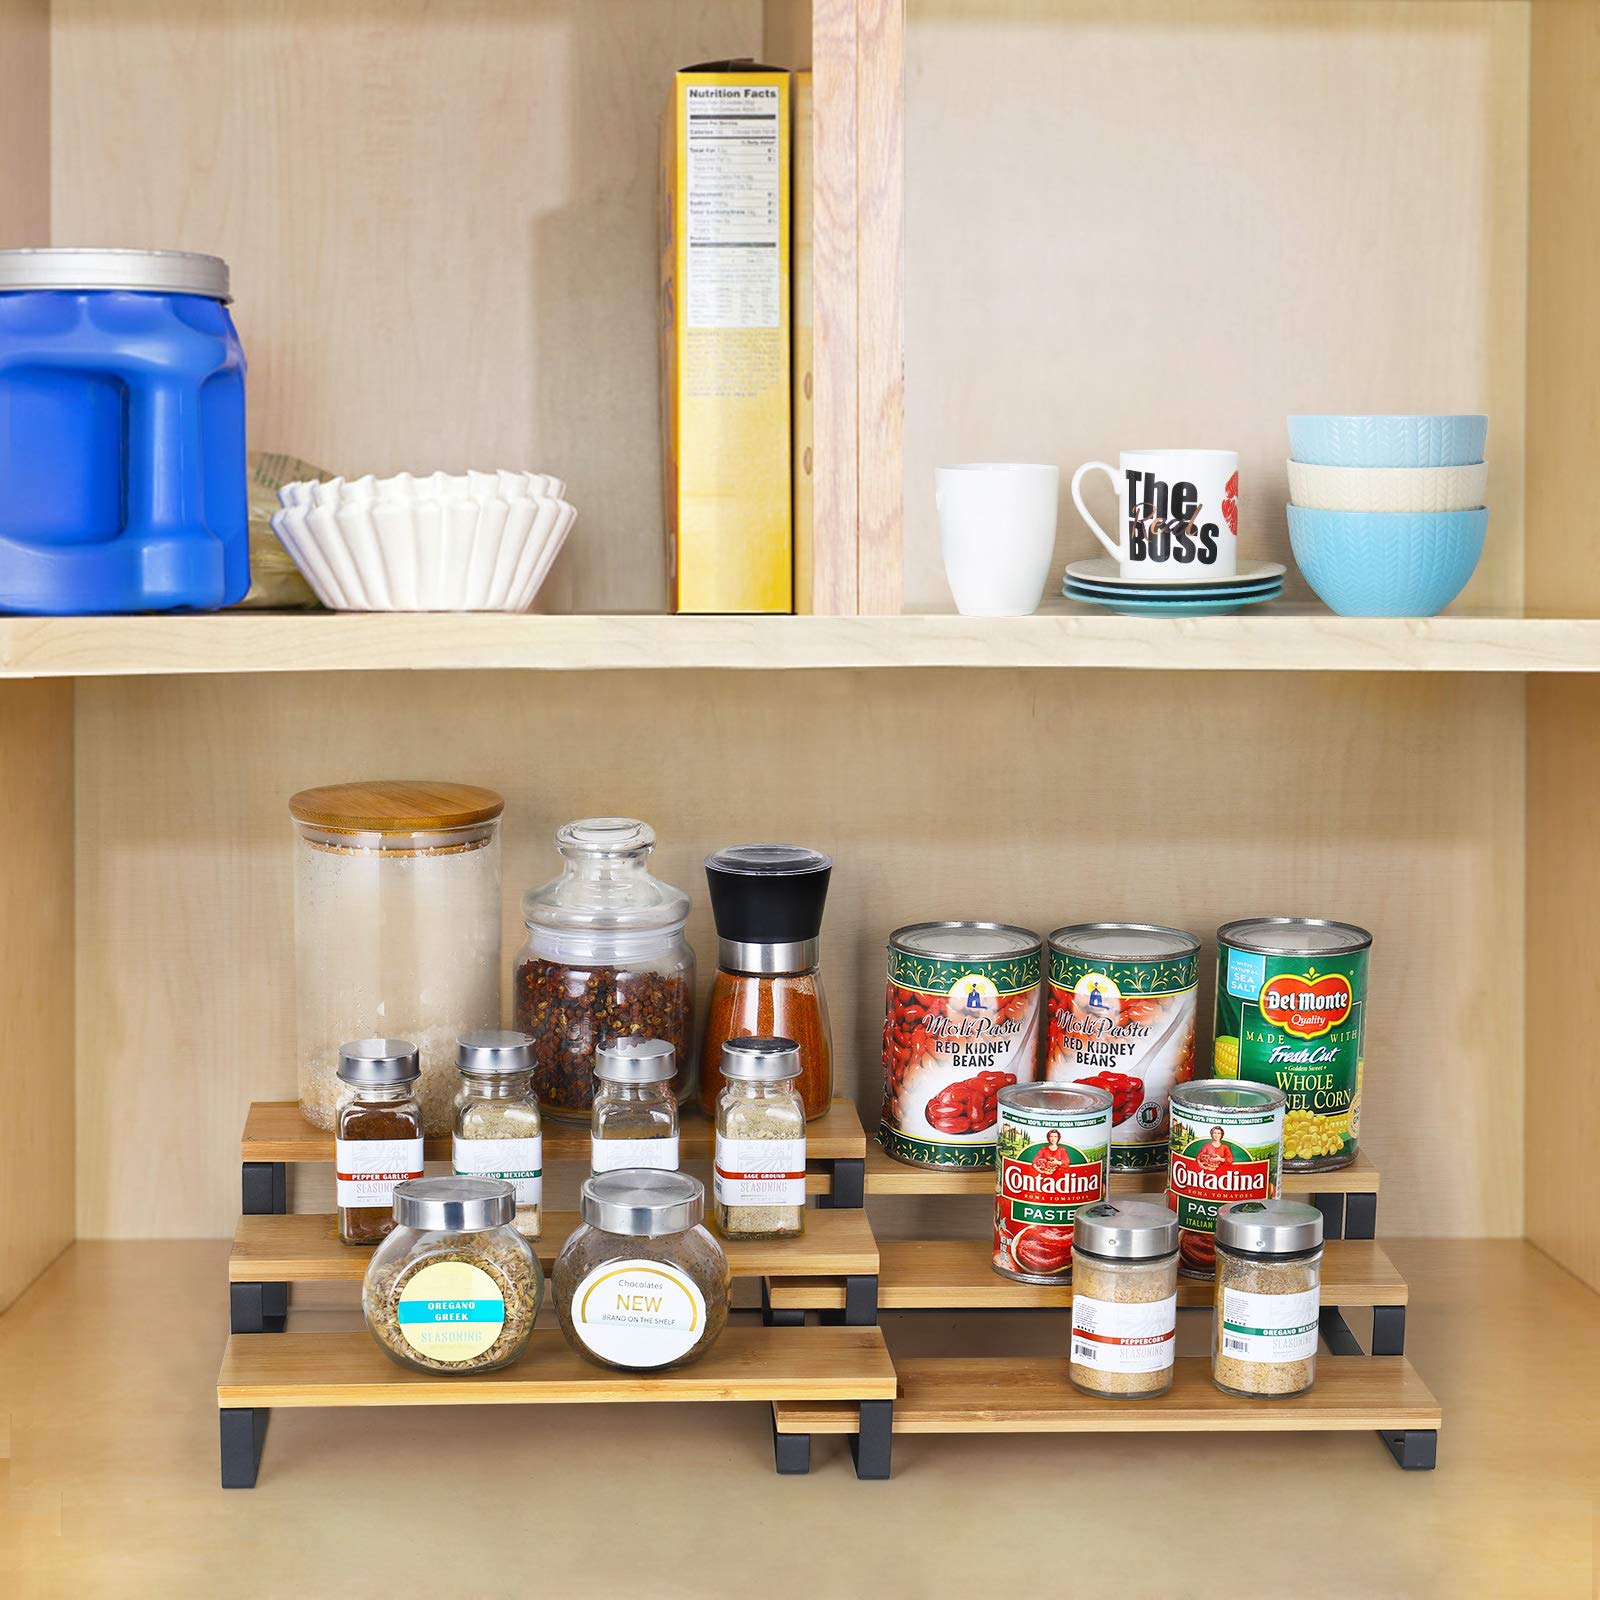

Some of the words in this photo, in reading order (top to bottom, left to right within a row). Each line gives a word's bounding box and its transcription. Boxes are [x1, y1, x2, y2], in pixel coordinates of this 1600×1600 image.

[689, 89, 741, 98] Nutrition
[744, 89, 776, 98] Facts
[1126, 469, 1198, 521] The
[1129, 520, 1220, 565] BOSS
[1231, 965, 1259, 975] NATURAL
[1233, 972, 1255, 984] SEA
[1231, 980, 1257, 993] SALT
[1267, 990, 1296, 1010] Del
[1298, 991, 1348, 1011] Monte
[1290, 1013, 1326, 1027] Quality
[1246, 1031, 1285, 1044] MADE
[1330, 1029, 1358, 1043] WITH
[936, 1040, 960, 1054] RED
[965, 1039, 1011, 1054] KIDNEY
[1063, 1035, 1083, 1051] RED
[1087, 1040, 1136, 1056] KIDNEY
[953, 1054, 995, 1068] BEANS
[1076, 1051, 1117, 1068] BEANS
[1268, 1045, 1310, 1064] Fresh
[1309, 1046, 1342, 1063] Cut
[1275, 1071, 1334, 1091] WHOLE
[1285, 1093, 1311, 1110] NEL
[1314, 1088, 1352, 1109] CORN
[1004, 1165, 1099, 1194] Contadina
[1172, 1160, 1265, 1191] Contadina
[356, 1182, 396, 1194] SEASONI
[740, 1181, 788, 1193] SEASONING
[1188, 1189, 1208, 1197] ROMA
[1024, 1193, 1045, 1201] ROMA
[1024, 1207, 1076, 1221] PASTE
[1188, 1202, 1218, 1217] PAS
[1186, 1217, 1213, 1230] ITALIAN
[618, 1279, 664, 1290] Chocolates
[427, 1302, 476, 1310] OREGANO
[616, 1294, 663, 1313] NEW
[435, 1312, 469, 1321] GREEK
[602, 1314, 627, 1322] BRAND
[640, 1316, 654, 1325] THE
[654, 1317, 676, 1326] SHELF
[1262, 1328, 1297, 1336] OREGANO
[1120, 1336, 1165, 1345] PEPPERCORN
